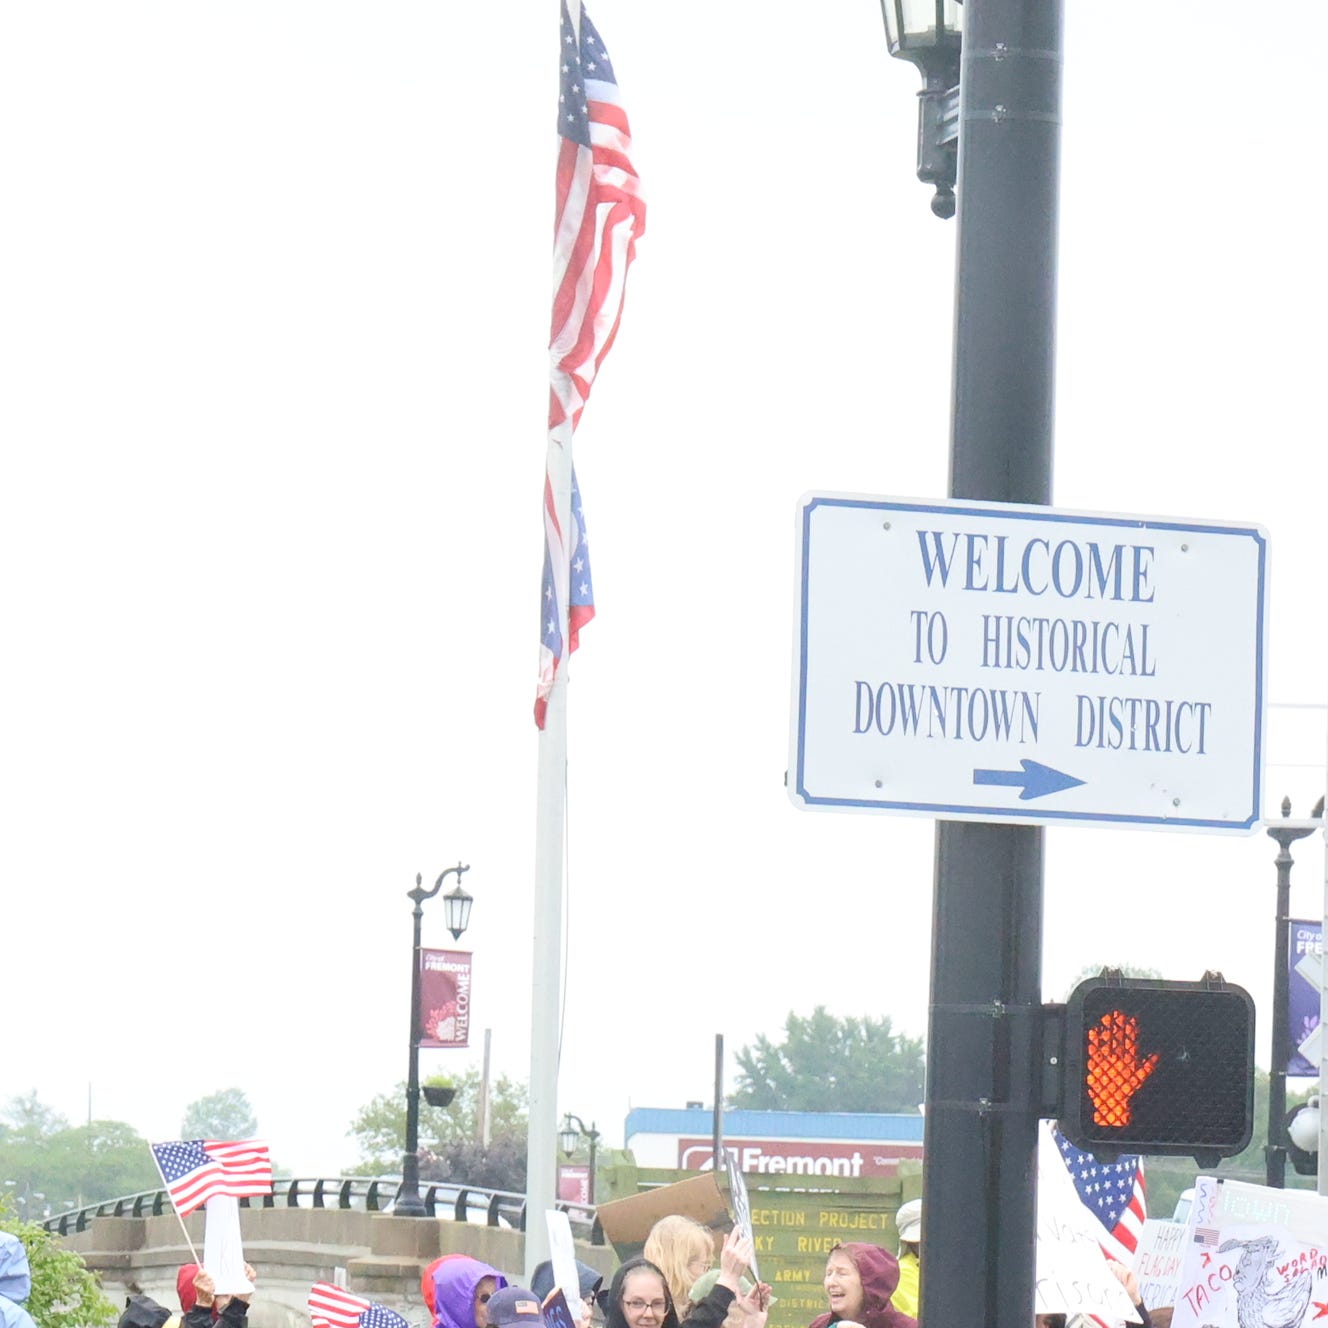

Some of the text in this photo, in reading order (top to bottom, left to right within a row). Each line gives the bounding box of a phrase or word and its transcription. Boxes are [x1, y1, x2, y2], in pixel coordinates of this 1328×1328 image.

[915, 529, 1156, 603] WELCOME
[910, 610, 1156, 677] TO HISTORICAL
[852, 680, 1212, 755] DOWNTOWN DISTRICT
[1297, 929, 1323, 941] City o
[425, 961, 470, 973] FREMONT
[455, 973, 470, 1042] WELCOME
[742, 1148, 864, 1177] Fremont
[751, 1209, 888, 1229] ECTION PROJECT
[1154, 1225, 1187, 1252] HAPPY
[1138, 1252, 1162, 1277] FLAG
[1276, 1248, 1319, 1276] WORD
[775, 1270, 811, 1283] ARMY
[1183, 1264, 1232, 1318] TACO
